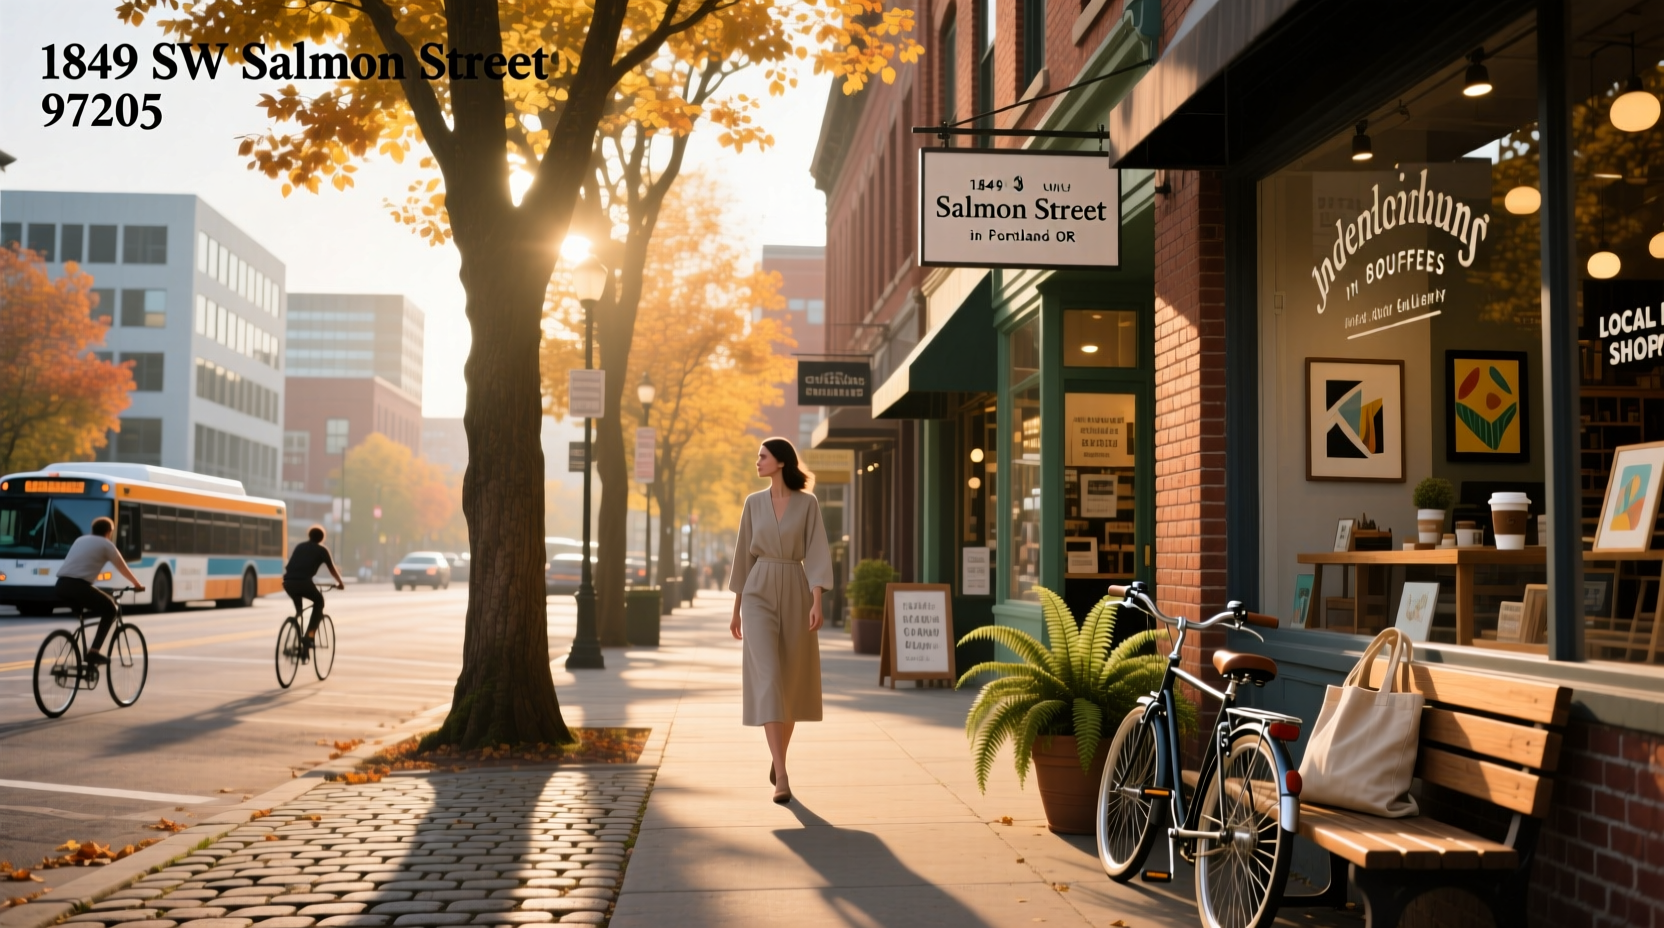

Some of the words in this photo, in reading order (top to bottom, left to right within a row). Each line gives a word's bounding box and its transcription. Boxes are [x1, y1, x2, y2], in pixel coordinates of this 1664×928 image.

[936, 195, 1027, 219] Salmon
[1034, 198, 1107, 221] Street
[970, 229, 982, 241] in
[1056, 230, 1076, 243] OR
[1599, 306, 1657, 338] LOCAL
